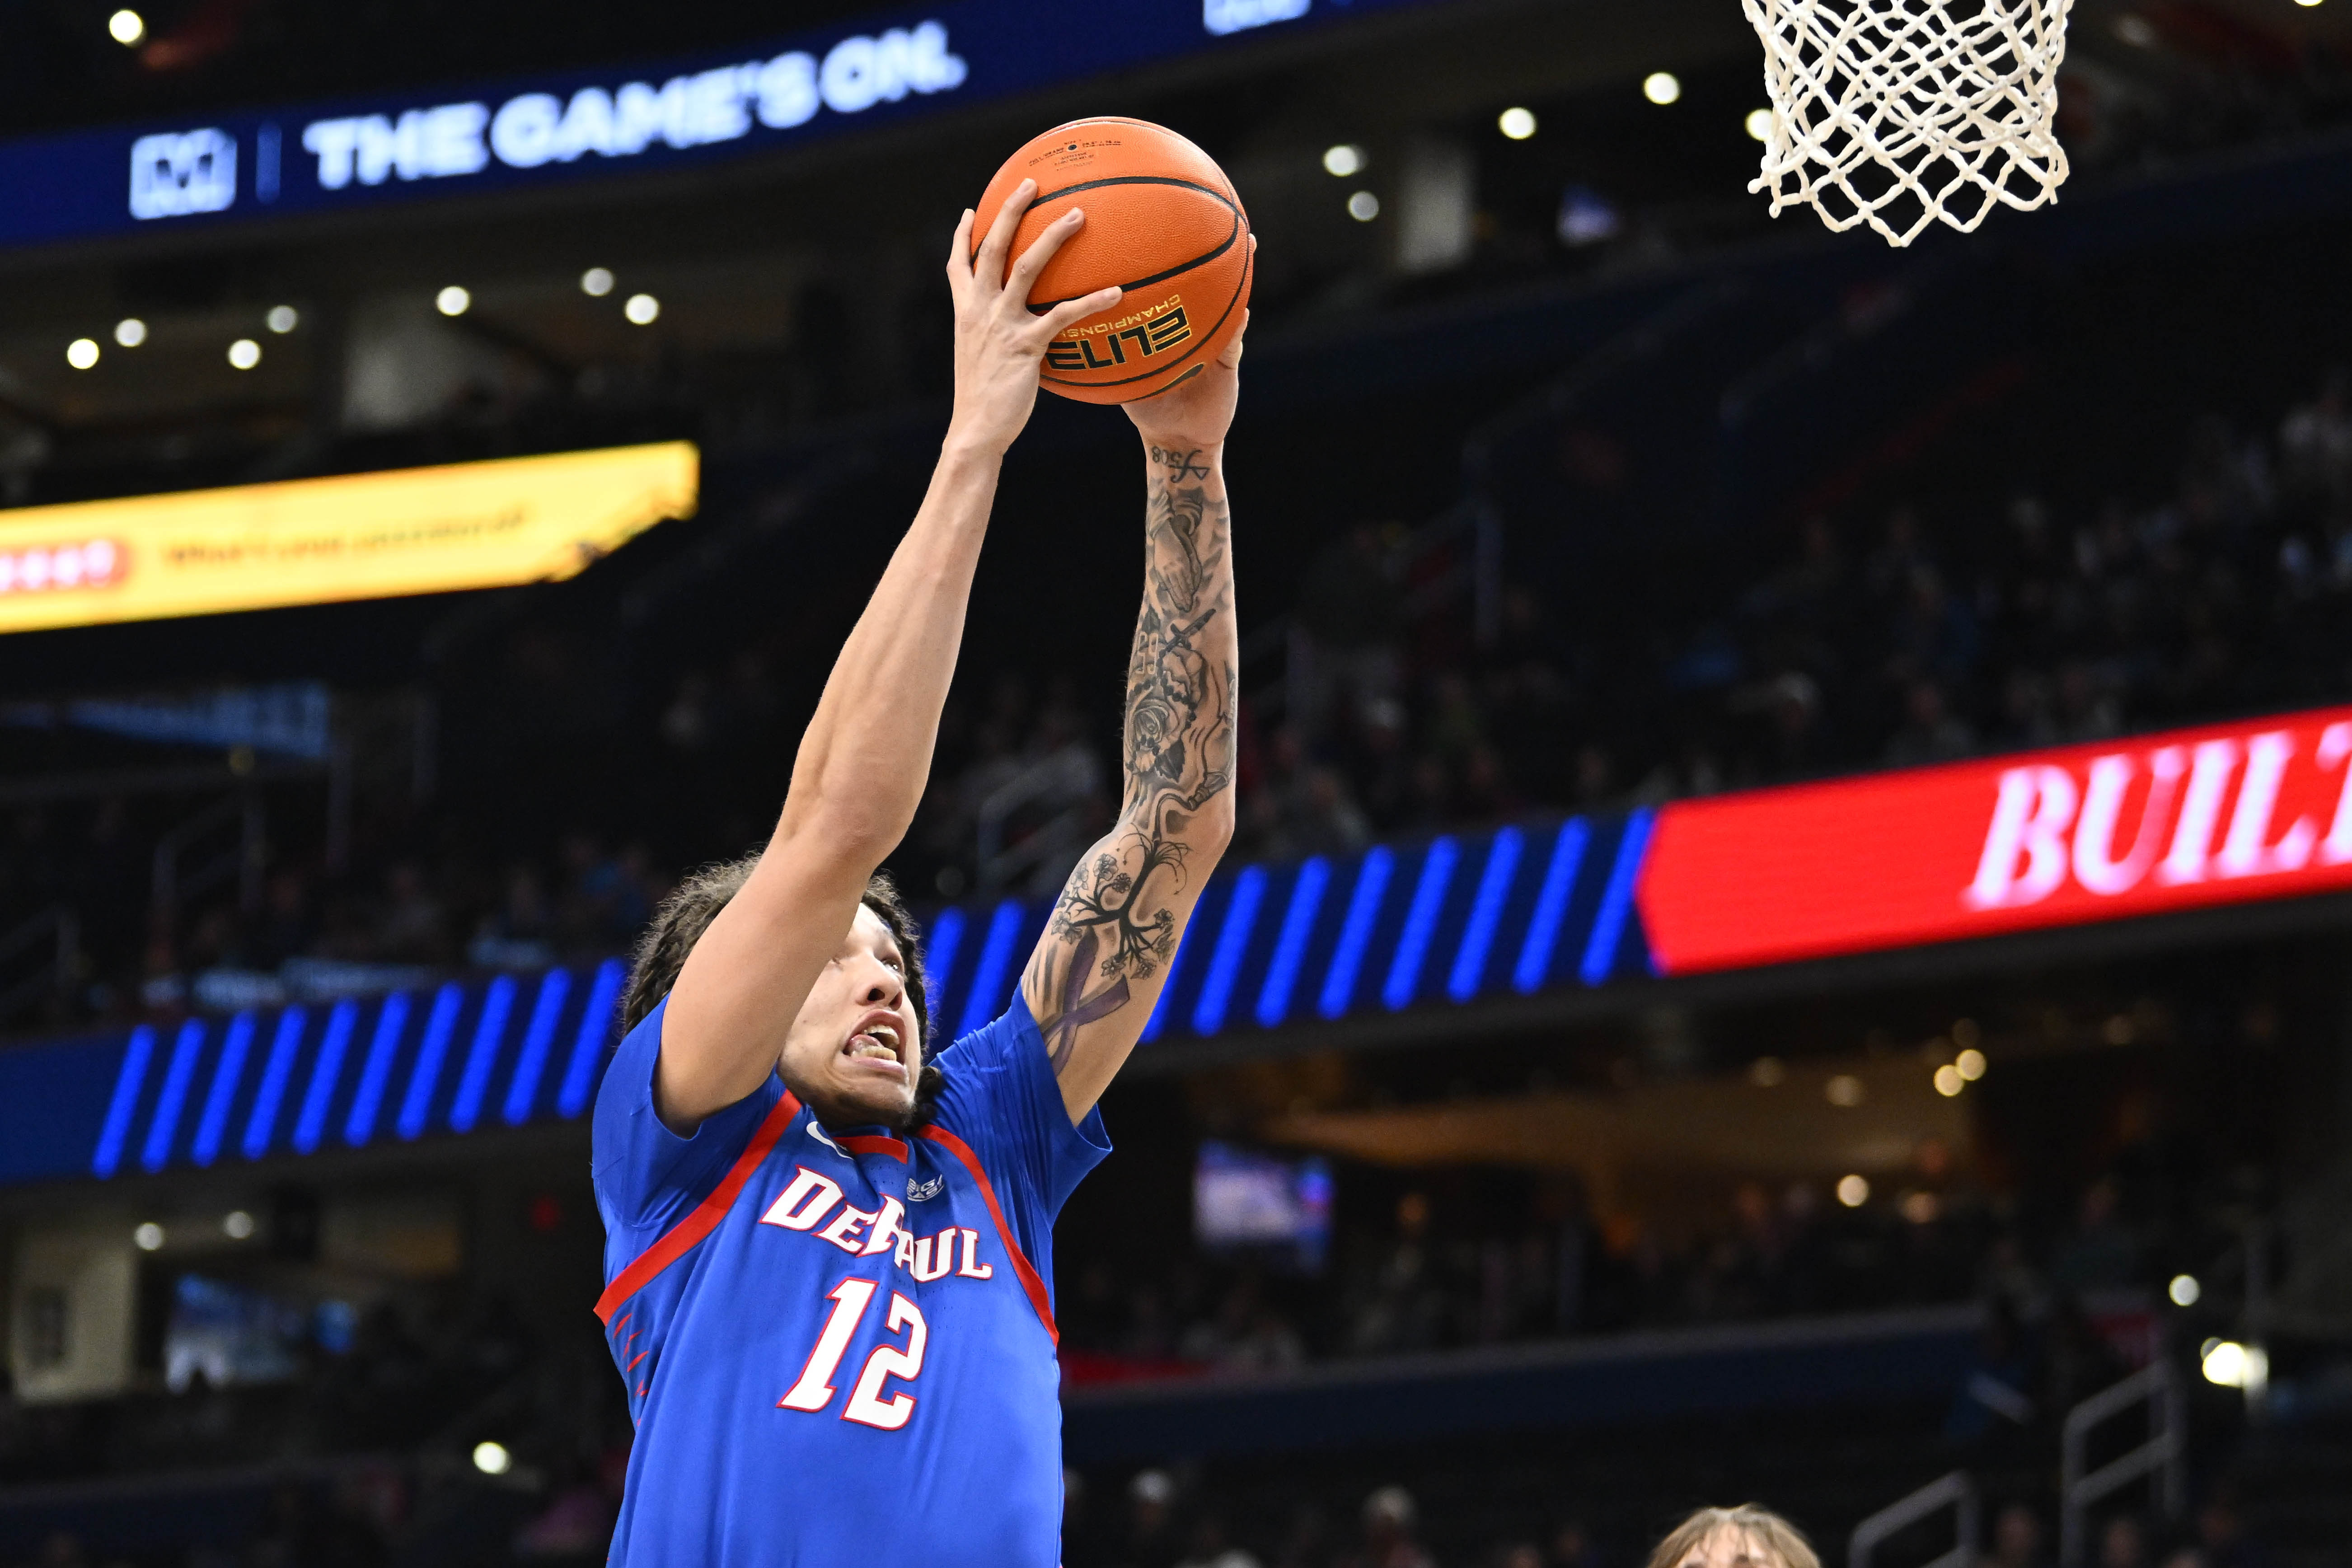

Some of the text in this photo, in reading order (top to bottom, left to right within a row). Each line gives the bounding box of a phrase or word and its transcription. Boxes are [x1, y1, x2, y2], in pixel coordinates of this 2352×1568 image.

[304, 102, 489, 189] THE
[490, 51, 819, 167] GAME'S
[1045, 304, 1192, 370] ELITE
[1060, 294, 1181, 338] CHAMPIONS
[775, 1276, 928, 1431] 12
